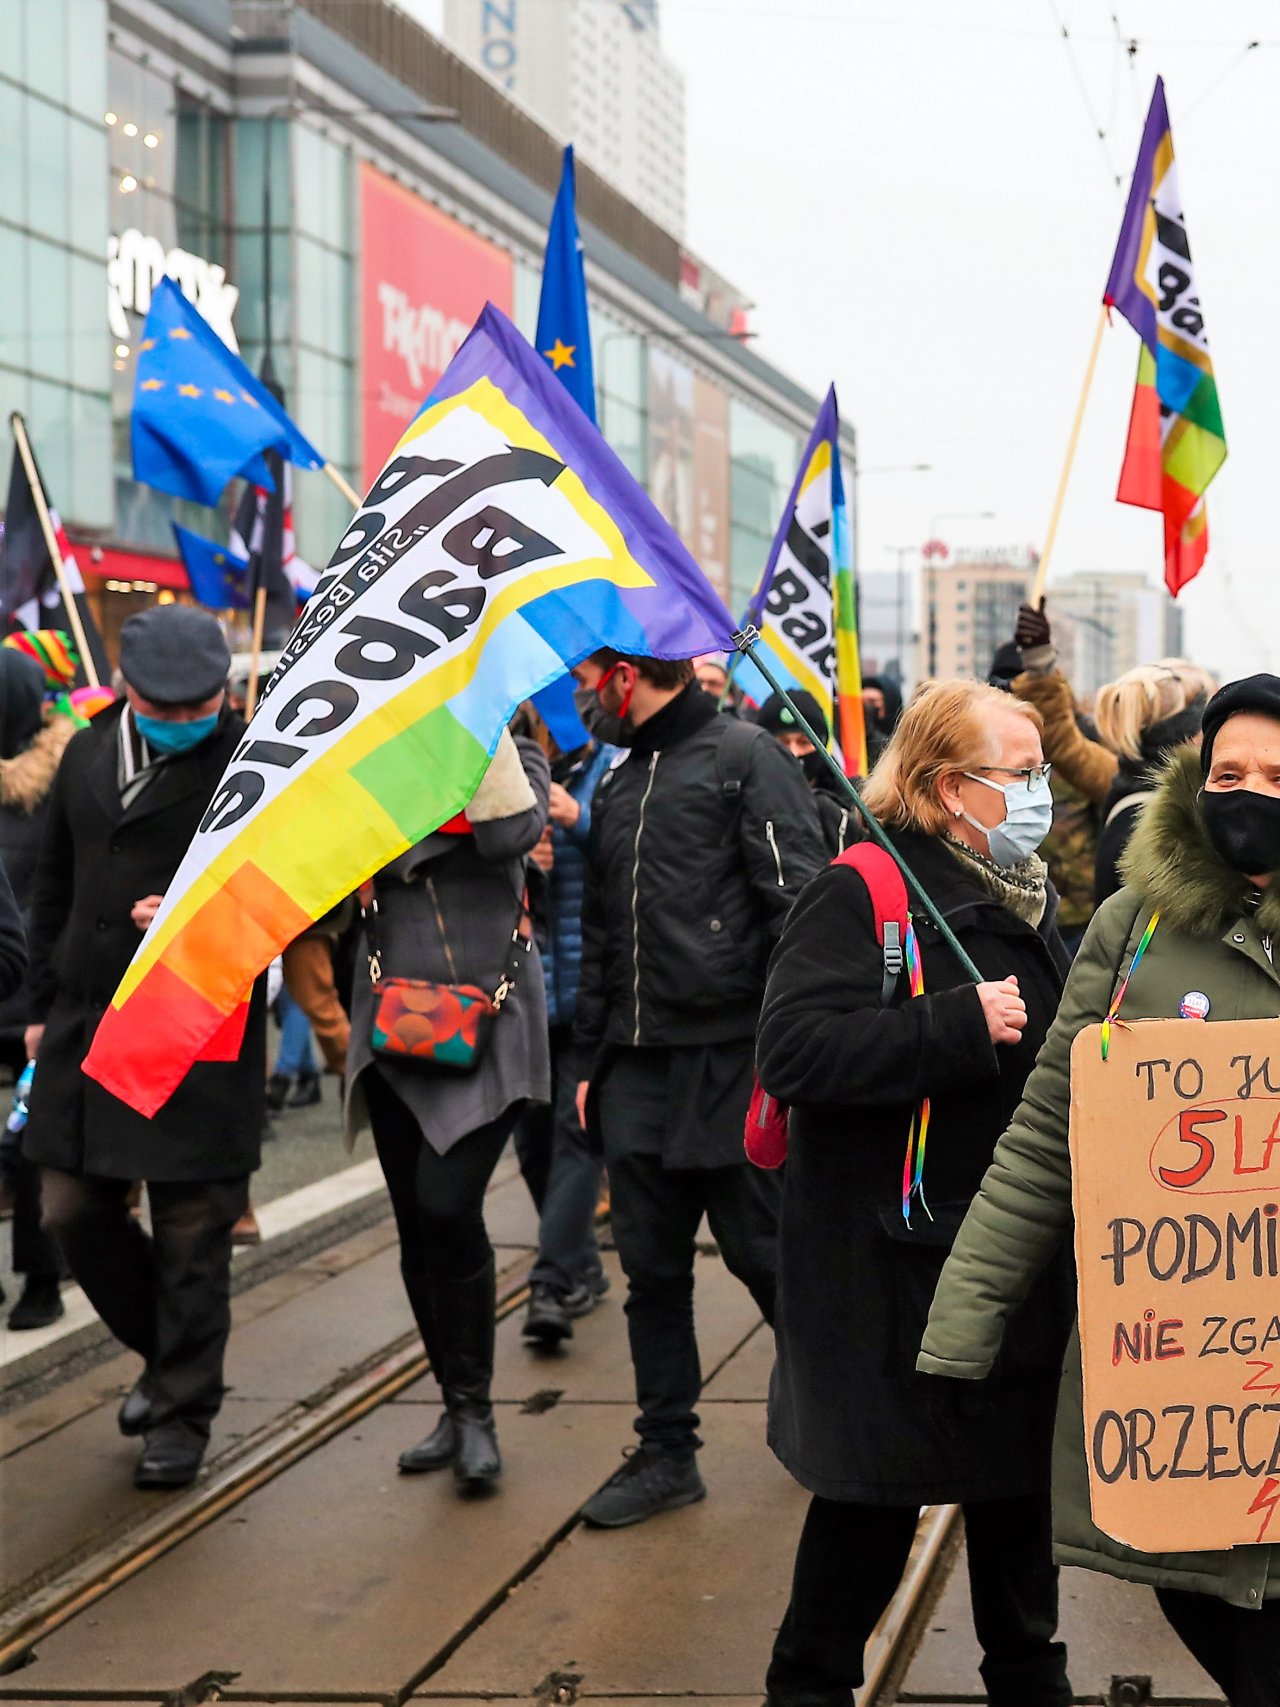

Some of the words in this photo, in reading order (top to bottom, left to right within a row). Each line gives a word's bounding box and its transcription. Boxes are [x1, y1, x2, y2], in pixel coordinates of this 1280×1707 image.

[480, 0, 518, 89] NO
[1158, 261, 1208, 345] Ba
[1136, 1057, 1204, 1100] TO
[1158, 1109, 1228, 1188] 5
